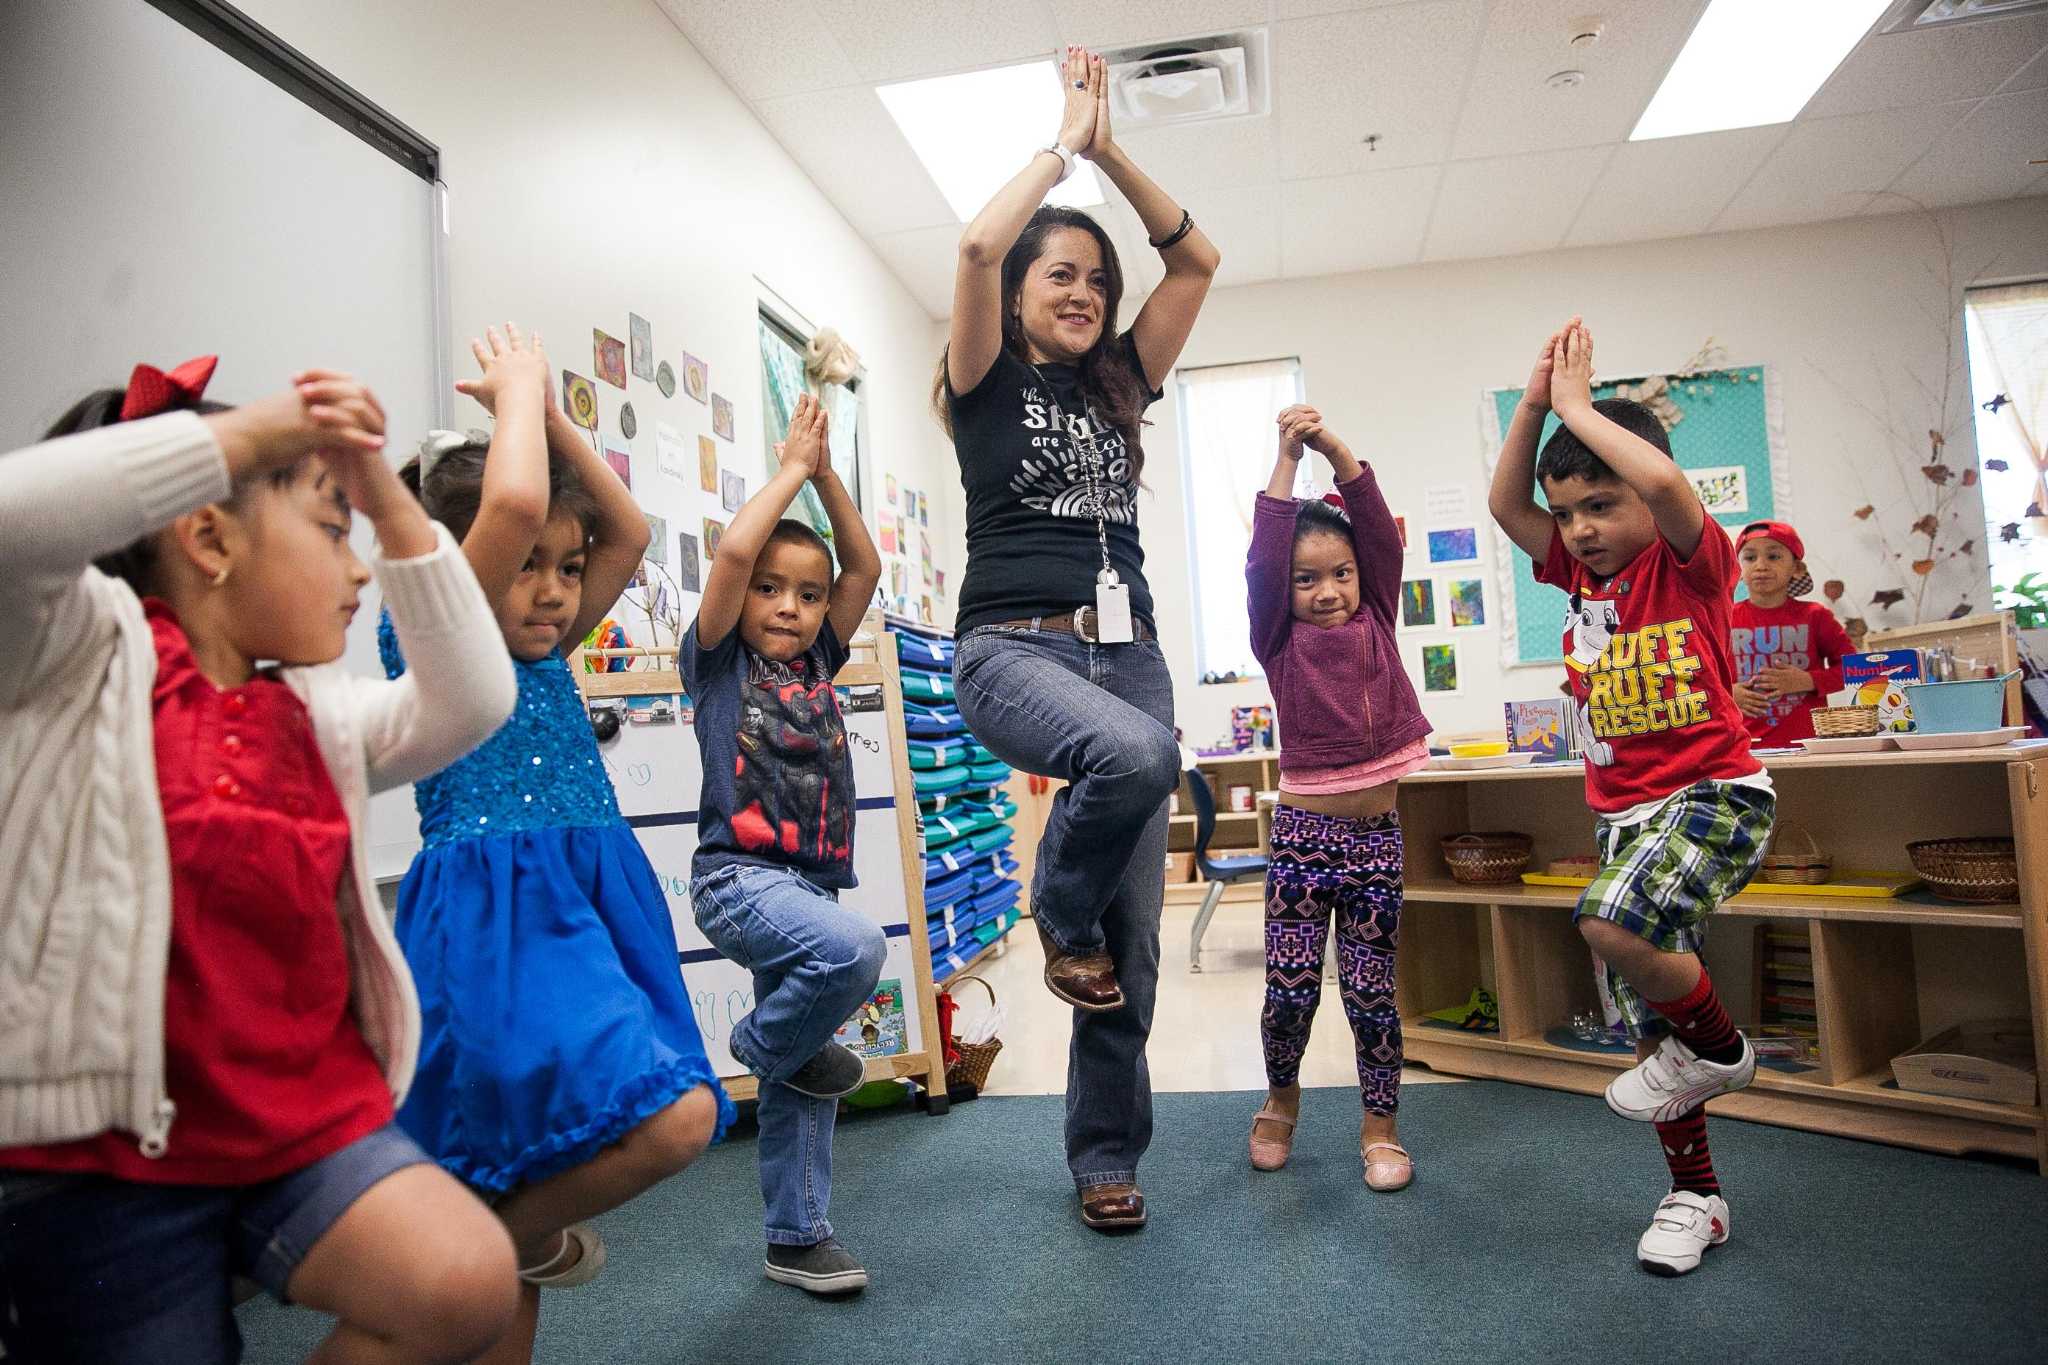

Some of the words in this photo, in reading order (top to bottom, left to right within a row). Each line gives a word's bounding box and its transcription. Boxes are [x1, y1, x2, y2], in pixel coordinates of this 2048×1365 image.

[1031, 436, 1059, 447] are
[1731, 624, 1808, 656] RUN
[1589, 656, 1701, 708] RUFF
[1590, 691, 1711, 737] RESCUE
